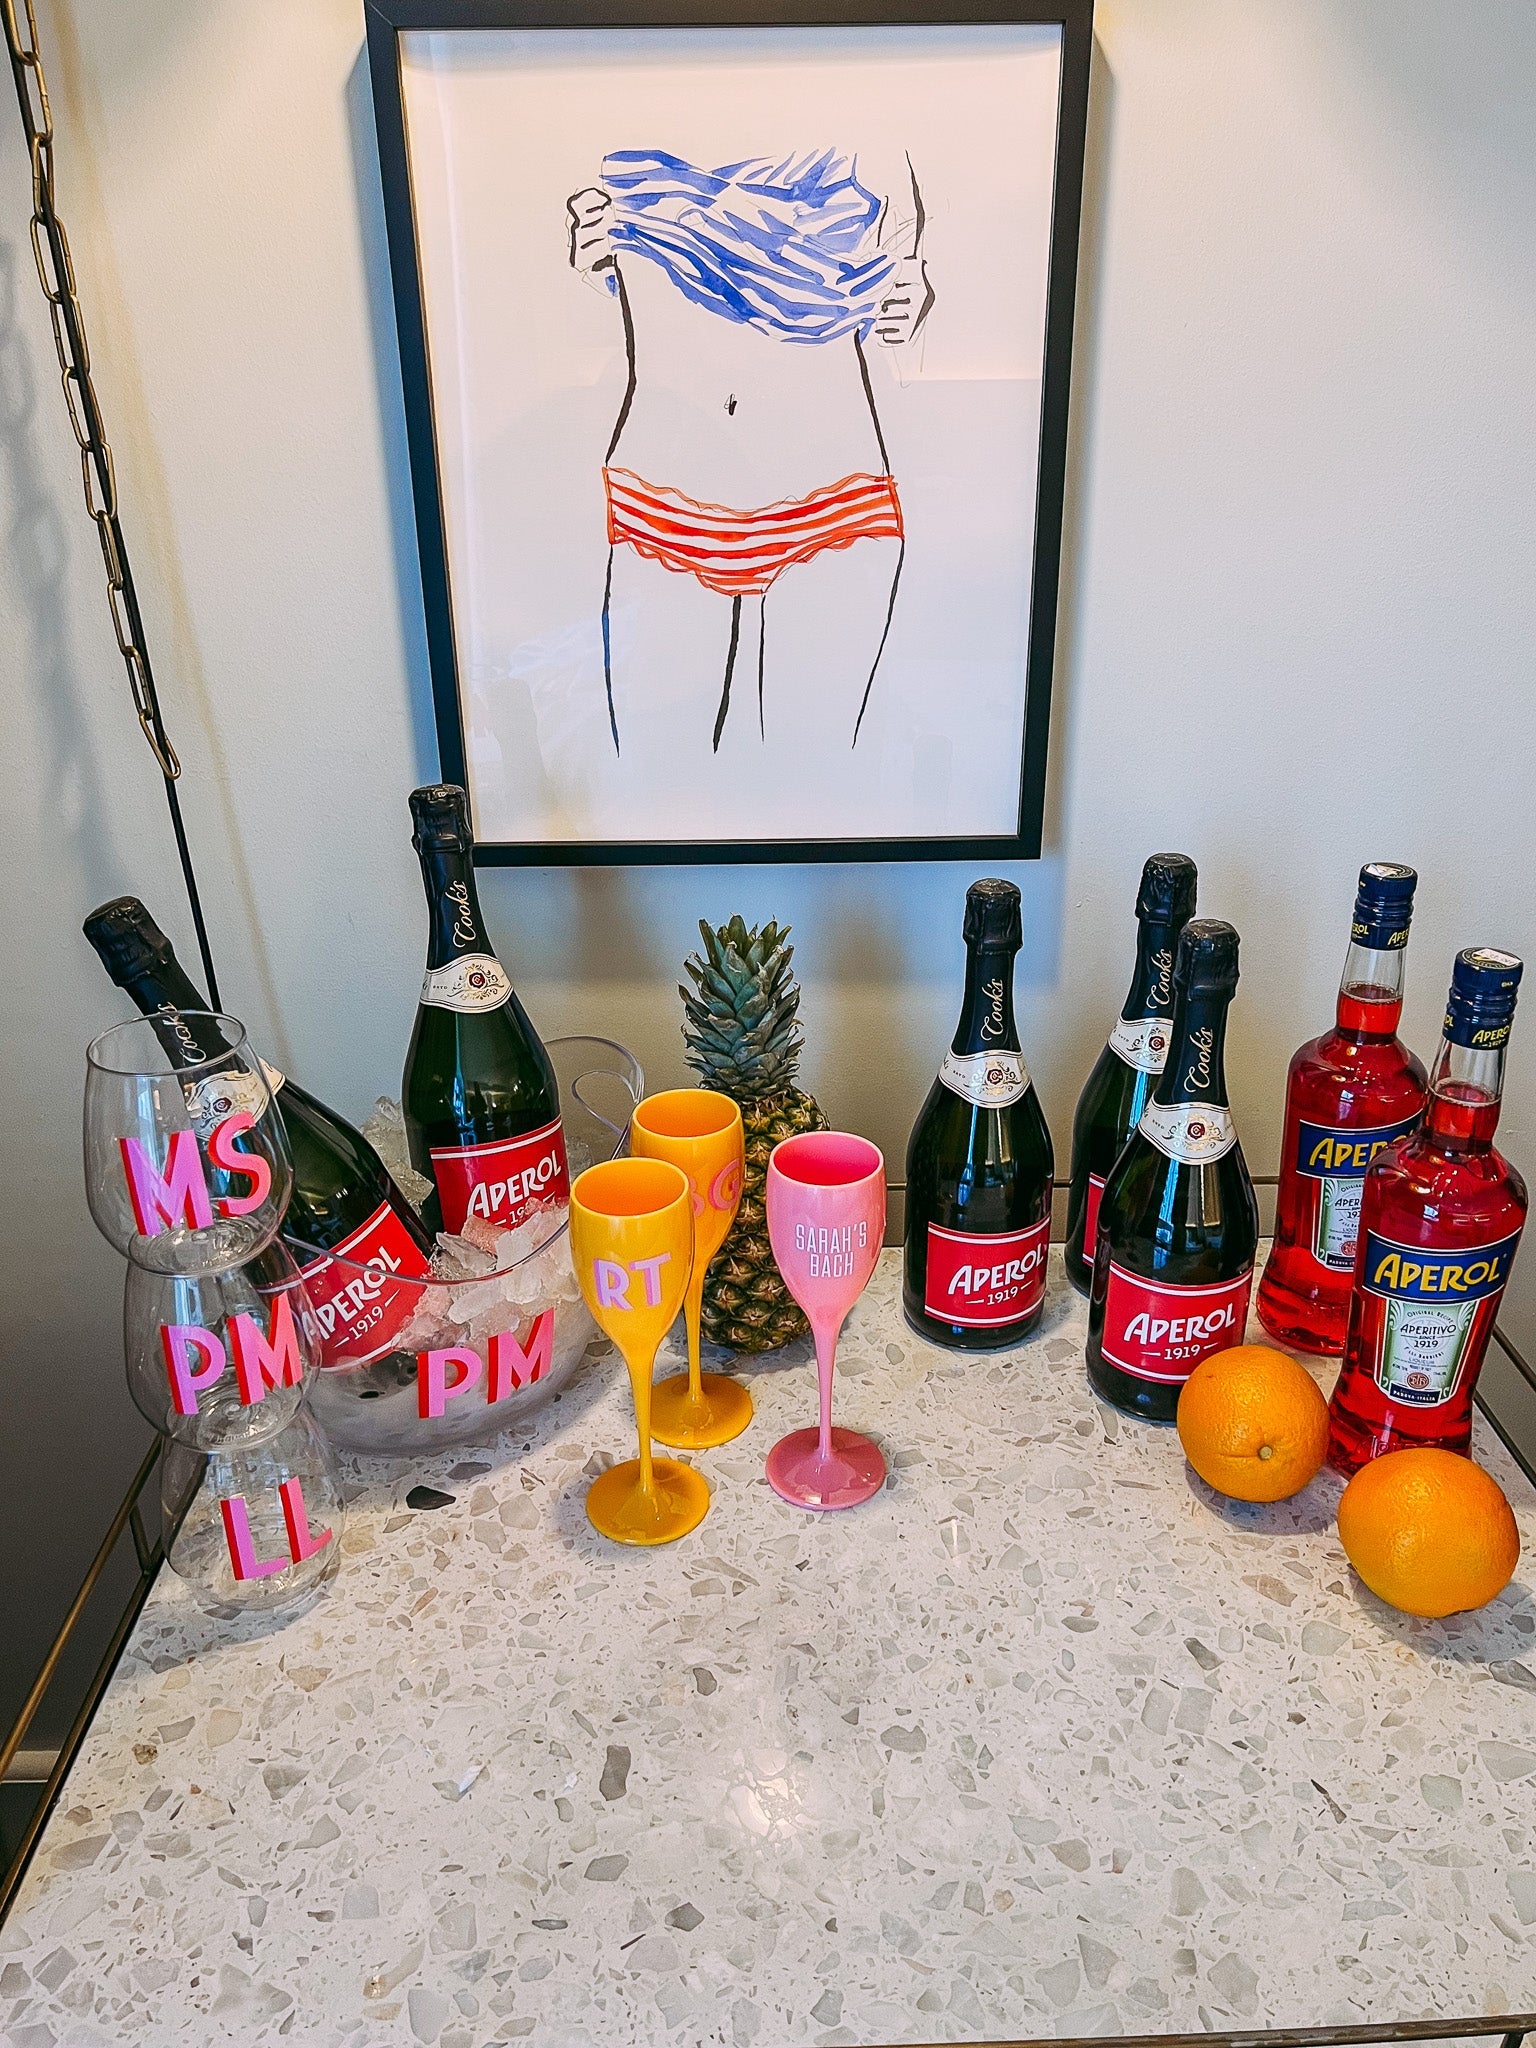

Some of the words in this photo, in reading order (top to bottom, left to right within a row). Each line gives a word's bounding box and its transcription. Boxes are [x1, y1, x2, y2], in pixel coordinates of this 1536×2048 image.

[445, 880, 476, 948] Cook's
[1146, 948, 1173, 1009] Cook's
[980, 978, 1004, 1041] Cook's
[1471, 1025, 1512, 1044] APERO
[1183, 1026, 1213, 1093] Cook's
[119, 1111, 272, 1236] MS
[467, 1149, 562, 1218] APEROL
[795, 1221, 867, 1253] SARAH'S
[810, 1251, 853, 1278] BACH
[302, 1246, 402, 1346] APEROL
[593, 1252, 671, 1311] RT
[948, 1242, 1044, 1295] APEROL
[987, 1286, 1019, 1306] 1919
[1373, 1253, 1500, 1292] APEROL
[349, 1305, 384, 1340] 1919
[1123, 1302, 1236, 1345] APEROL
[1400, 1324, 1456, 1335] APERITIVO
[1413, 1339, 1439, 1348] 1919
[160, 1291, 303, 1415] PM
[417, 1307, 555, 1419] PM
[1163, 1344, 1201, 1360] 1919
[220, 1475, 333, 1581] LL
